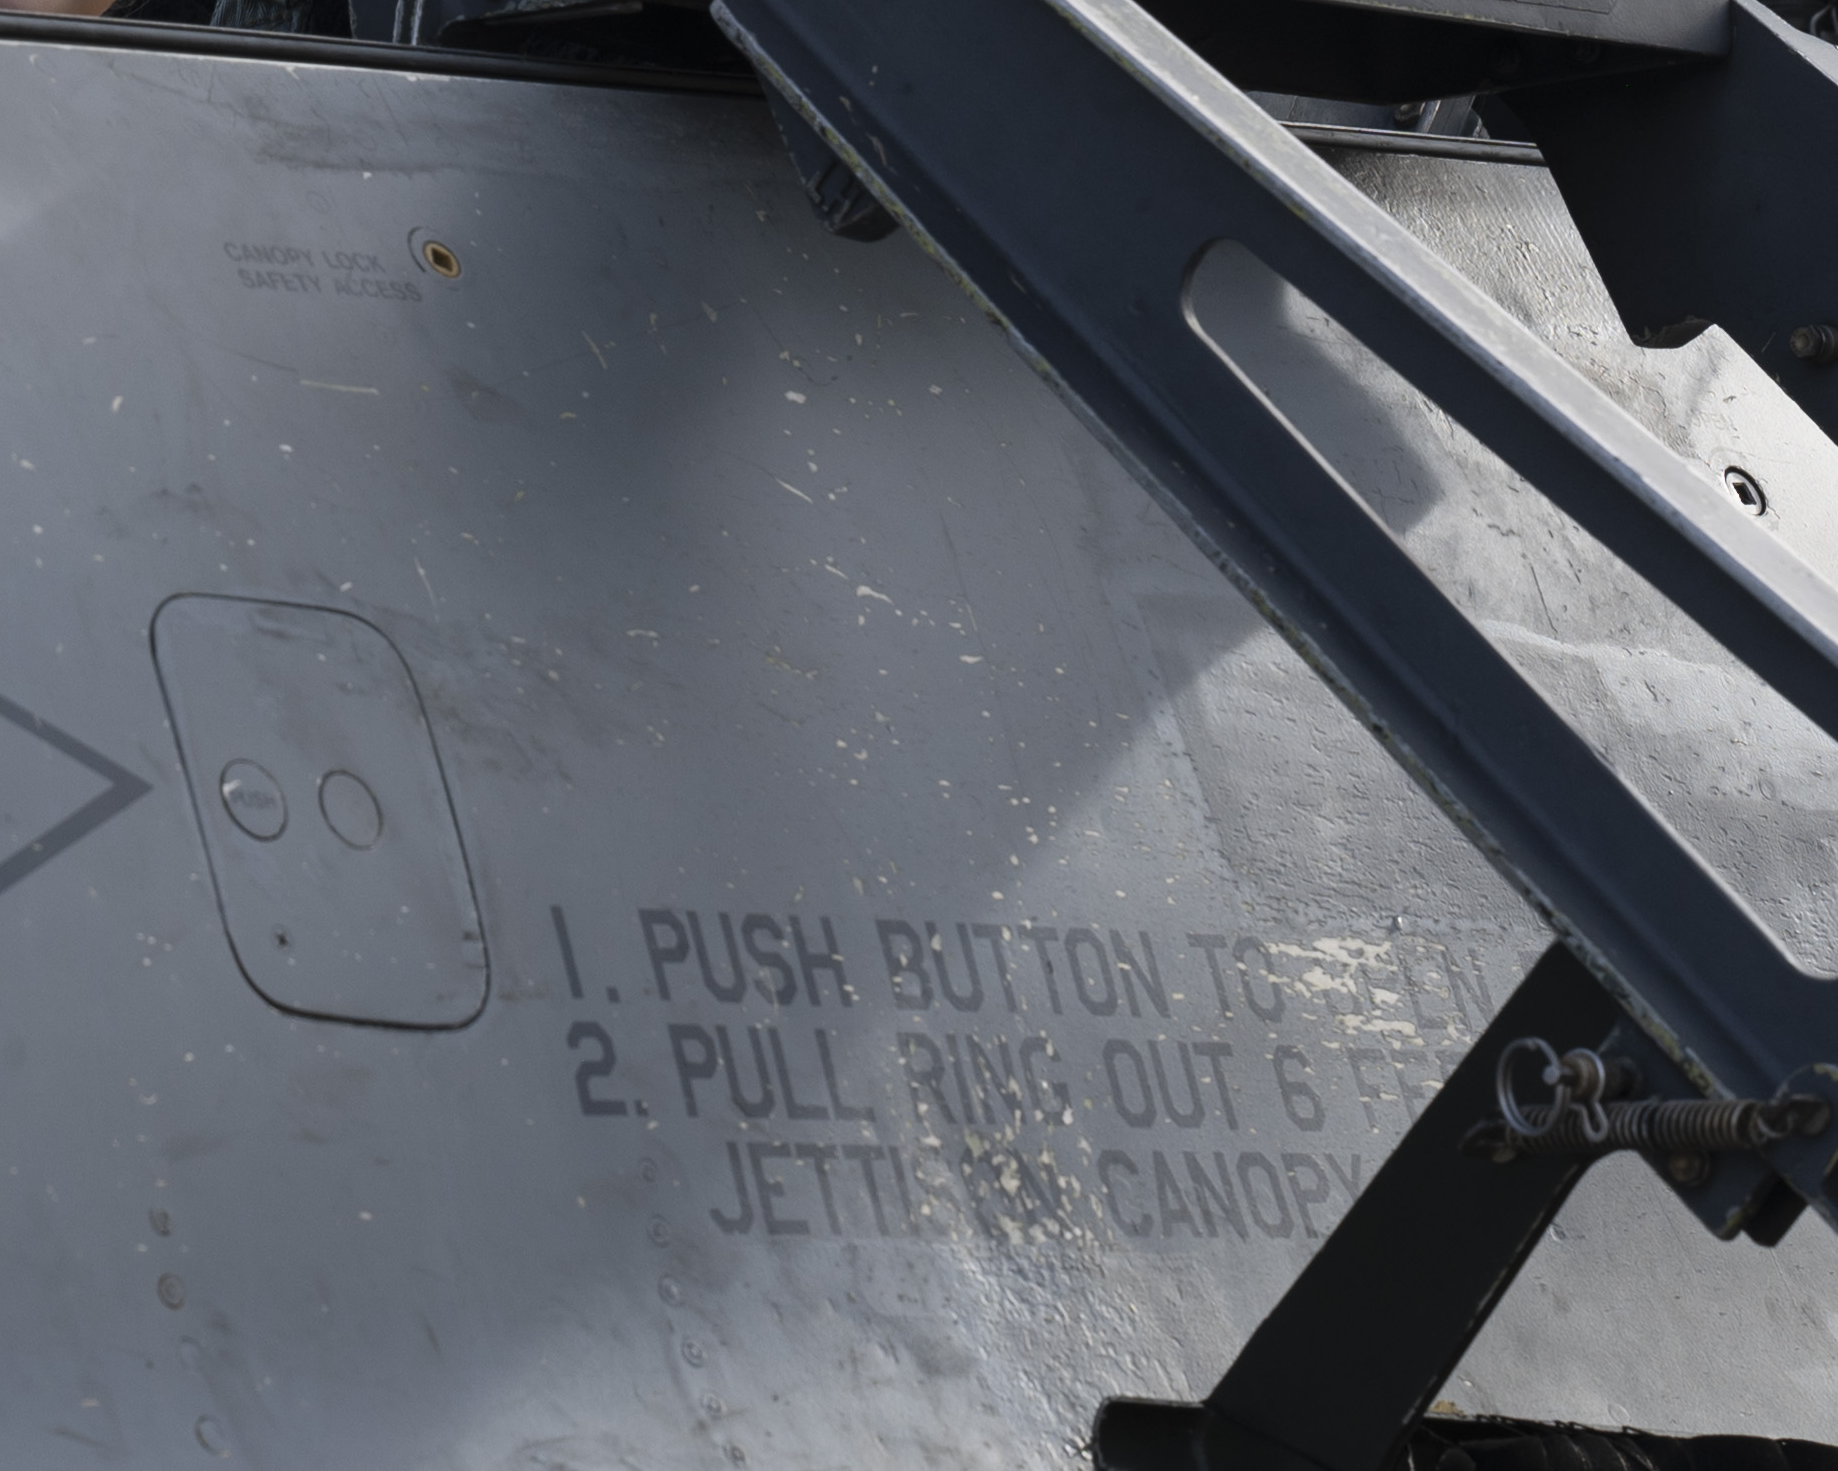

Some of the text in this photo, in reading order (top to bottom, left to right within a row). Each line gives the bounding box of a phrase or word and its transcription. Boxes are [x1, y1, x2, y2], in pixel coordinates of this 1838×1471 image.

[223, 241, 387, 274] CANOPY LOCK
[237, 267, 423, 303] SAFETY ACCESS
[550, 905, 621, 1003] 1.
[638, 908, 854, 1008] PUSH
[875, 918, 1171, 1019] BUTTON
[1186, 932, 1287, 1024] TO
[567, 1021, 650, 1118] 2.
[668, 1024, 877, 1121] PULL
[896, 1032, 1073, 1126] RING
[1102, 1038, 1239, 1131] OUT
[1273, 1044, 1327, 1132] 6
[1097, 1149, 1363, 1242] CANOPY
